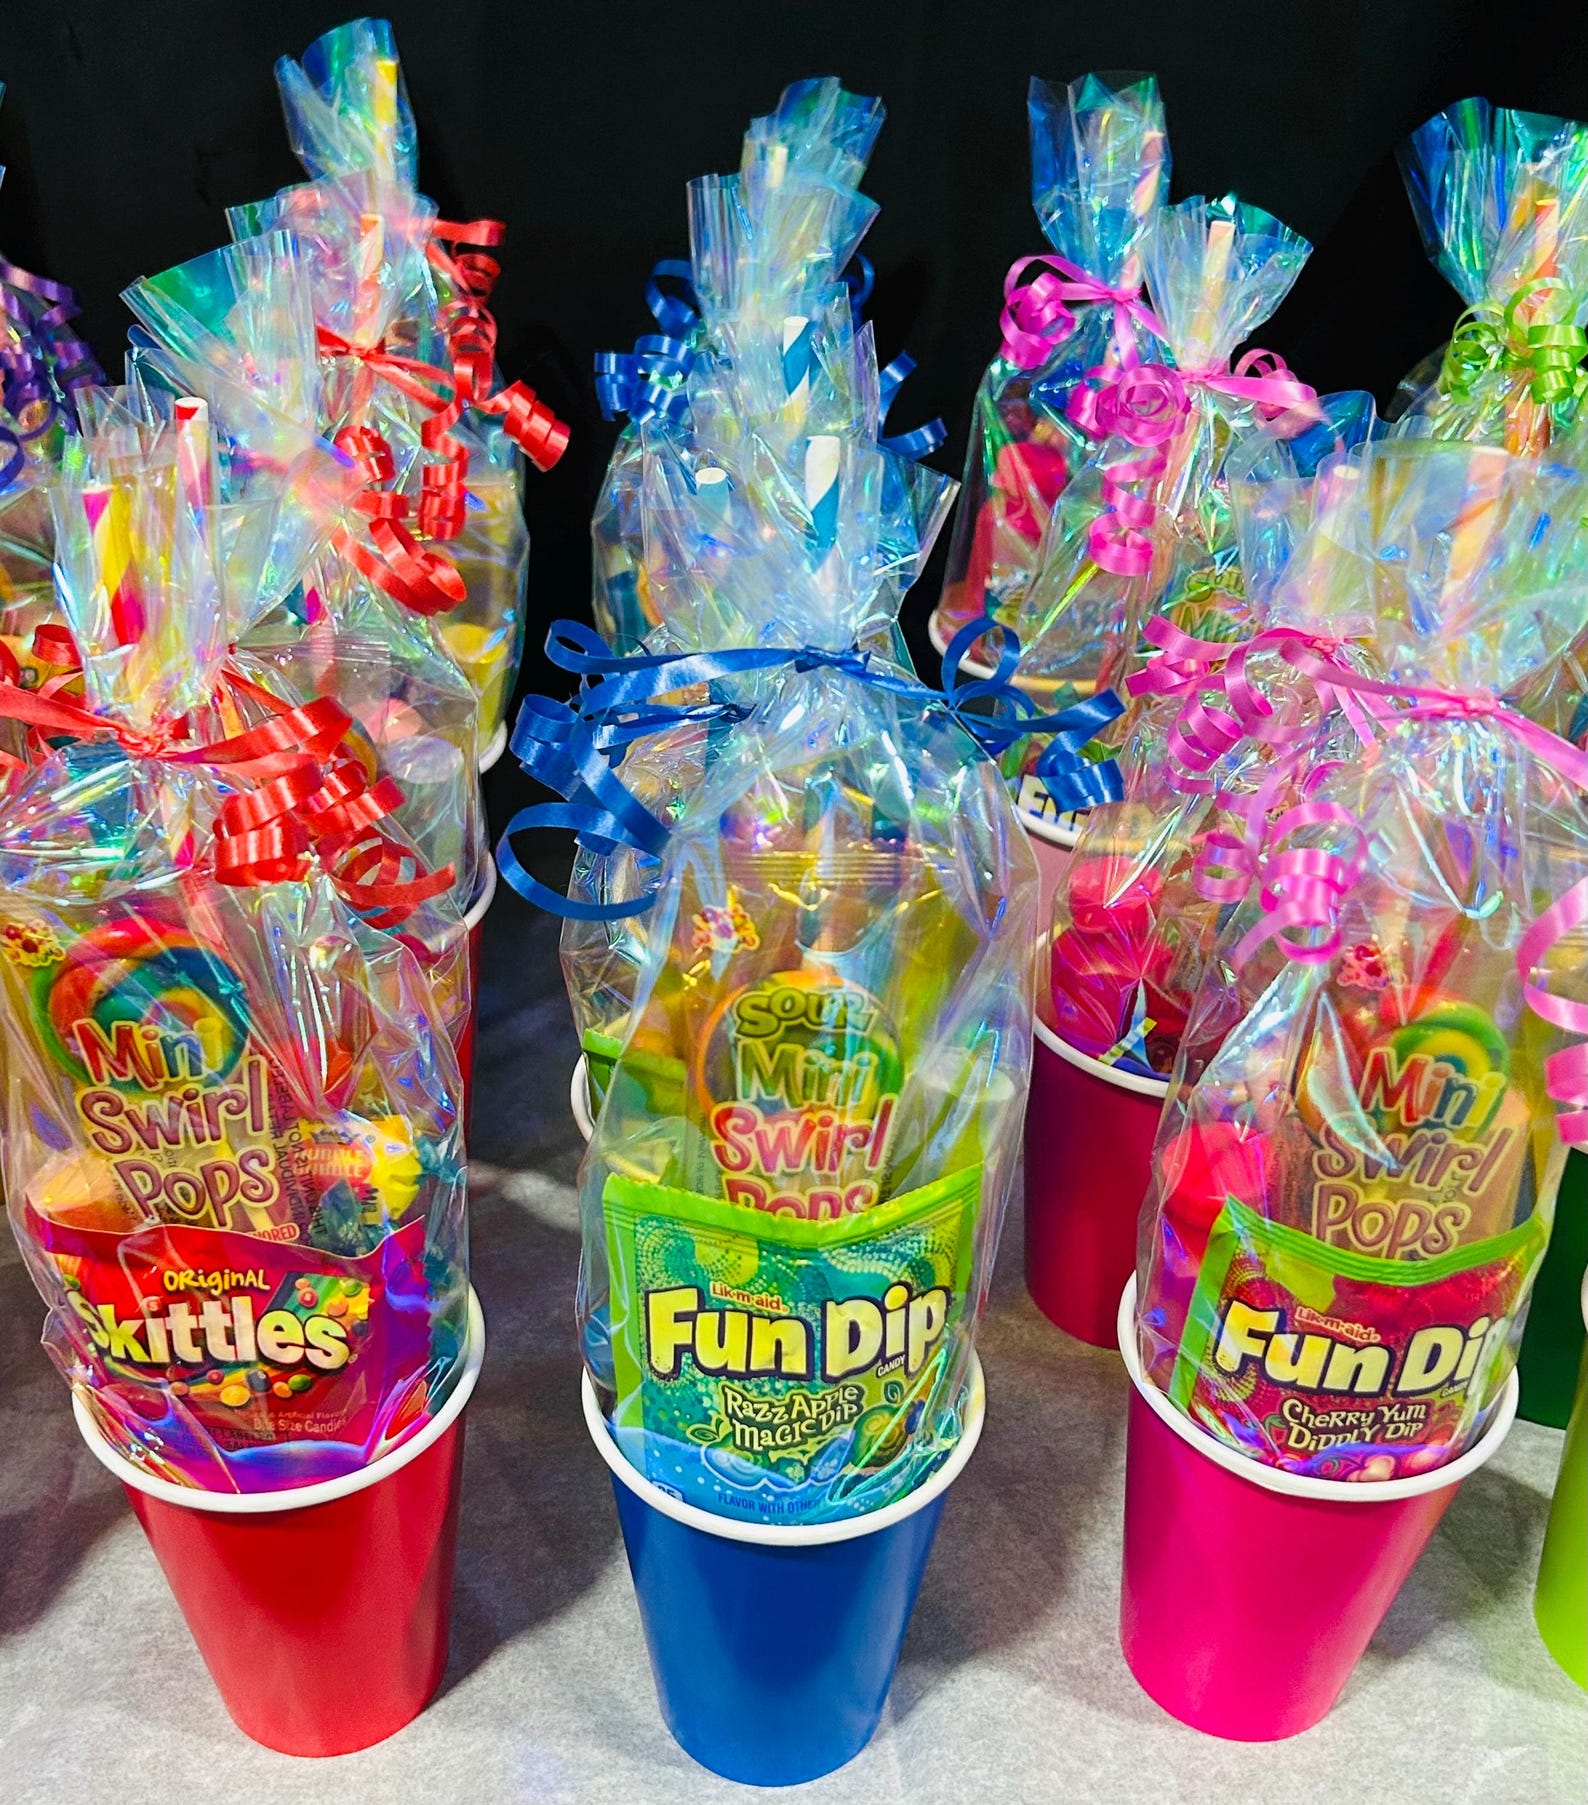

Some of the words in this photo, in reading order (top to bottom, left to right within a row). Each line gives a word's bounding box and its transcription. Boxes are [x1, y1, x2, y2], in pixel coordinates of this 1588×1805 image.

[74, 1017, 225, 1090] Mini
[738, 1041, 877, 1109] Mini
[1361, 1048, 1505, 1128] Mini
[80, 1056, 268, 1156] Swirl
[712, 1094, 899, 1176] Swirl
[114, 1147, 279, 1227] Pops
[1314, 1118, 1514, 1194] Swirl
[1313, 1180, 1470, 1258] Pops
[647, 1287, 810, 1377] Fun
[827, 1286, 948, 1377] Dip
[877, 1356, 905, 1378] CANDY
[1216, 1300, 1391, 1393] Fun
[717, 1492, 756, 1511] FLAVOR
[759, 1501, 784, 1515] WITH
